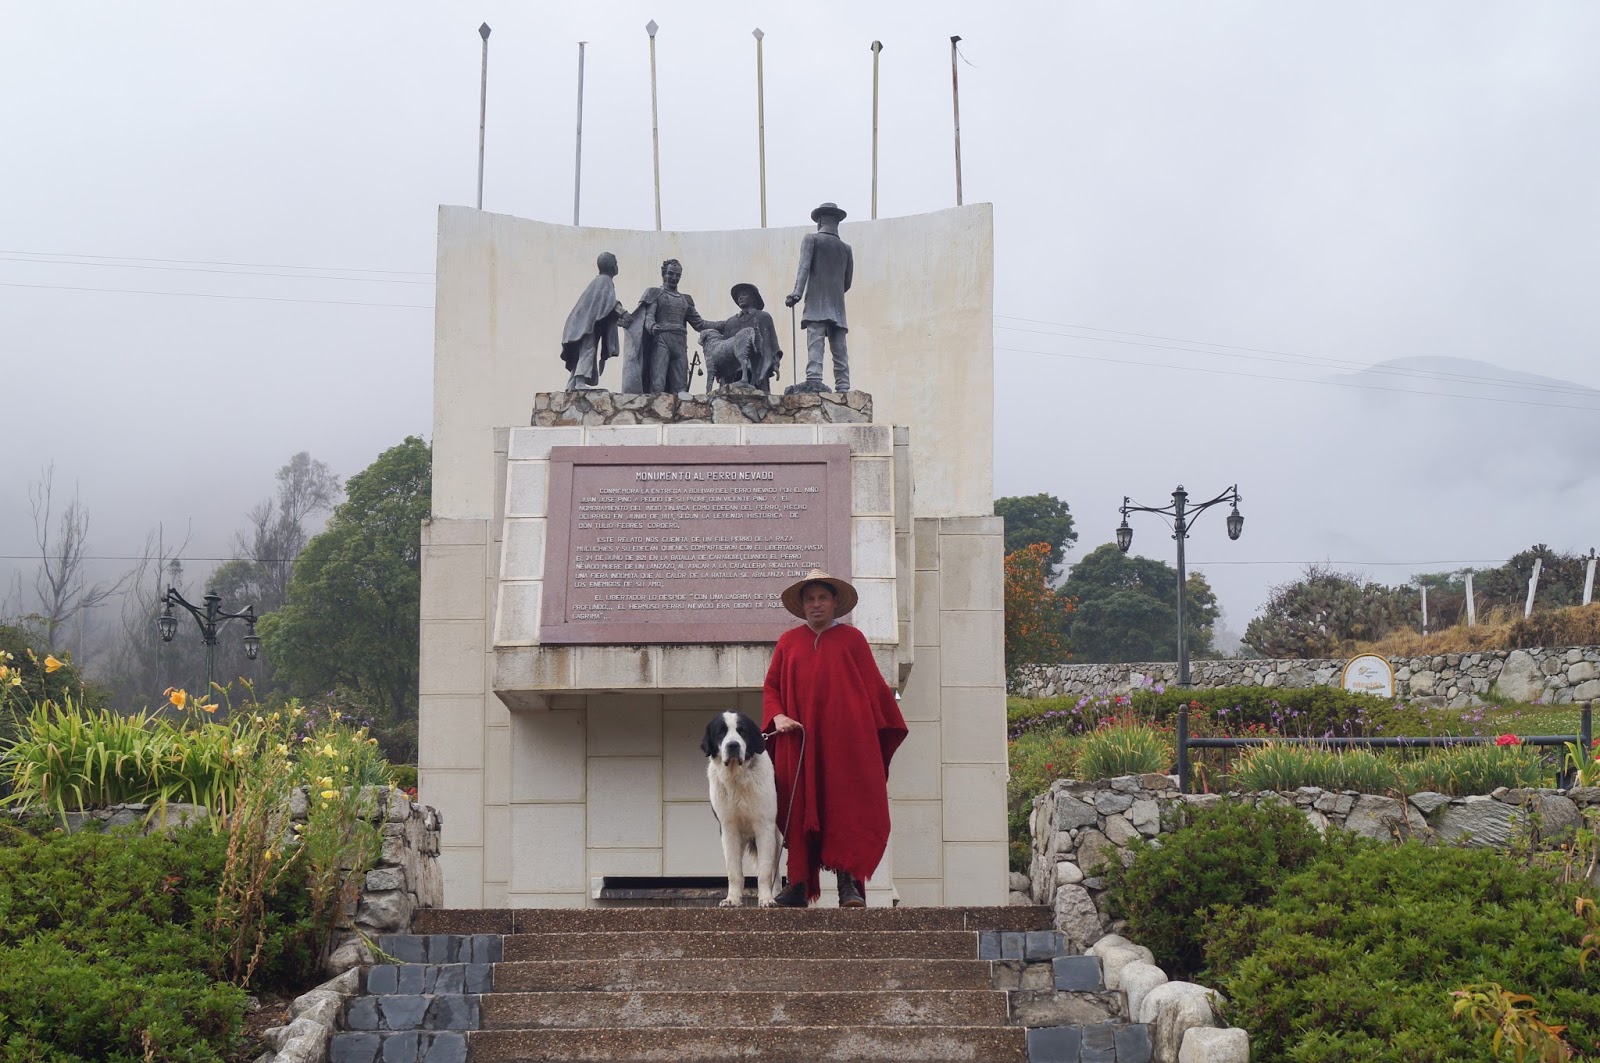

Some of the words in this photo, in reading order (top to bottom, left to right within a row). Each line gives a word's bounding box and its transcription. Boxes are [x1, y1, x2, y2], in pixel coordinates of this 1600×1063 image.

[636, 471, 691, 481] MONUMENTO
[694, 471, 704, 481] AL
[706, 471, 737, 481] PERRO
[739, 471, 774, 481] NEVADO
